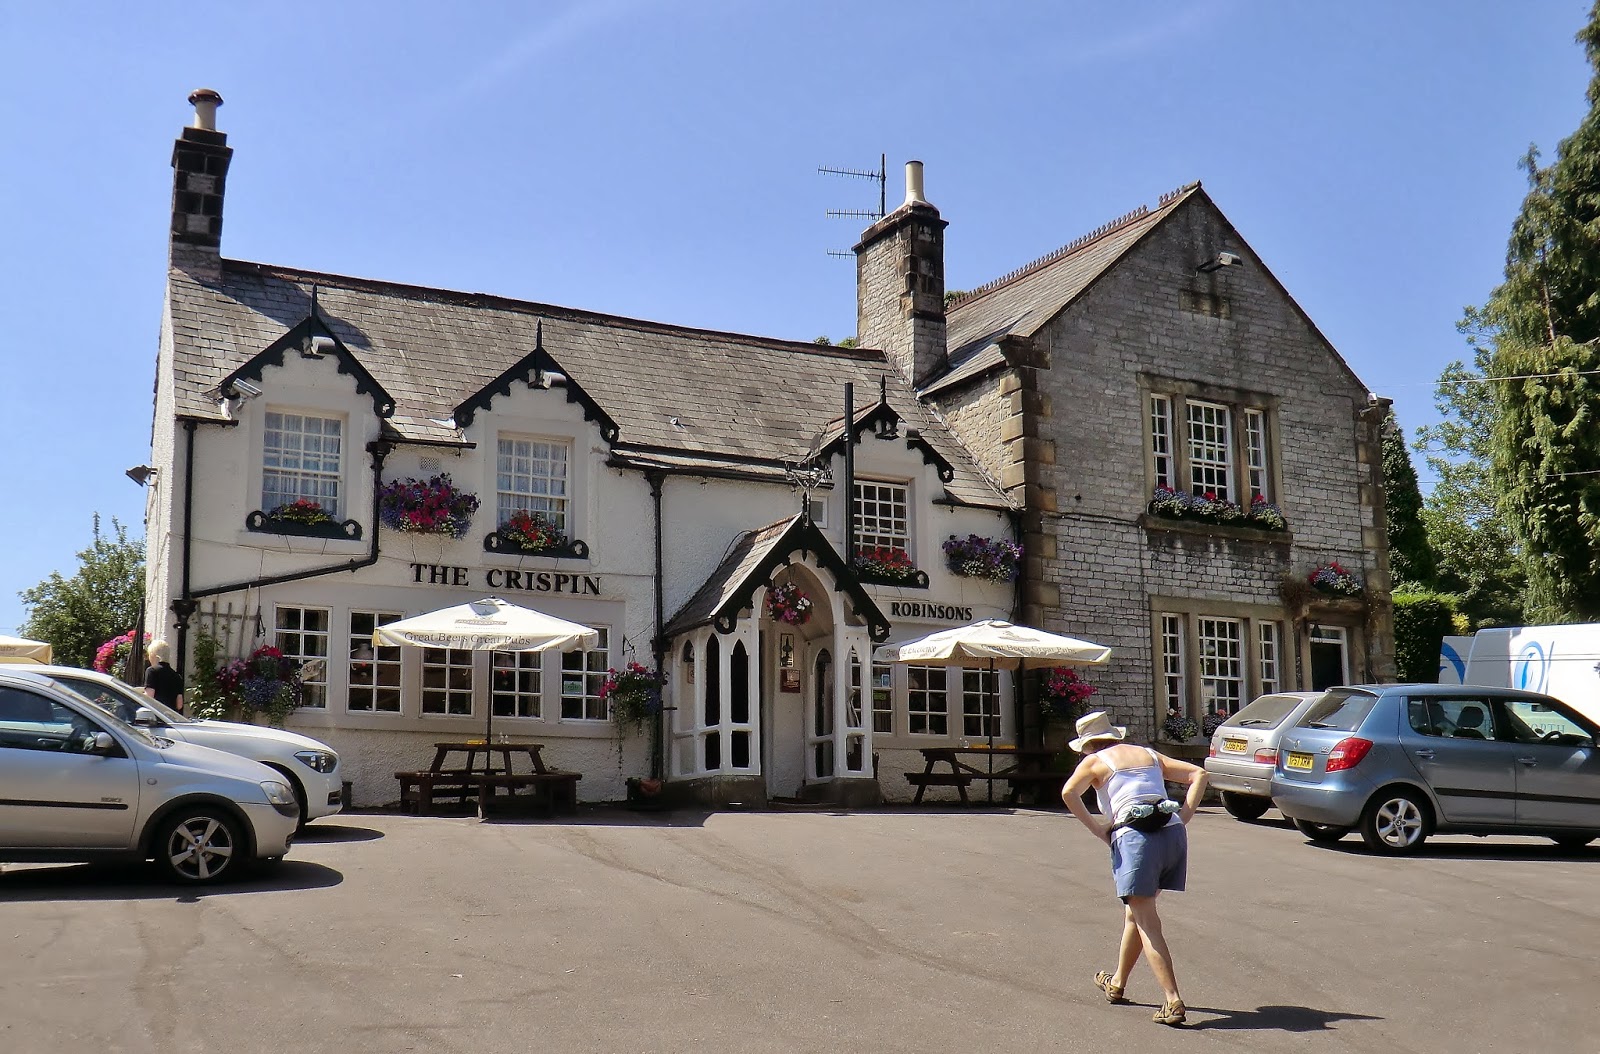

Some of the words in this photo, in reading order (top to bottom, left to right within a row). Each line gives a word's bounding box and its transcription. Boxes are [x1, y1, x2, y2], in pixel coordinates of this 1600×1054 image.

[410, 563, 469, 586] THE
[486, 568, 601, 595] CRISPIN
[891, 602, 973, 621] ROBINSONS
[404, 631, 434, 641] Great
[438, 633, 468, 642] Beers
[470, 634, 500, 644] Great
[504, 635, 531, 645] Pubs
[980, 643, 1004, 651] Great
[1032, 645, 1054, 653] Great
[1056, 646, 1077, 654] Pubs
